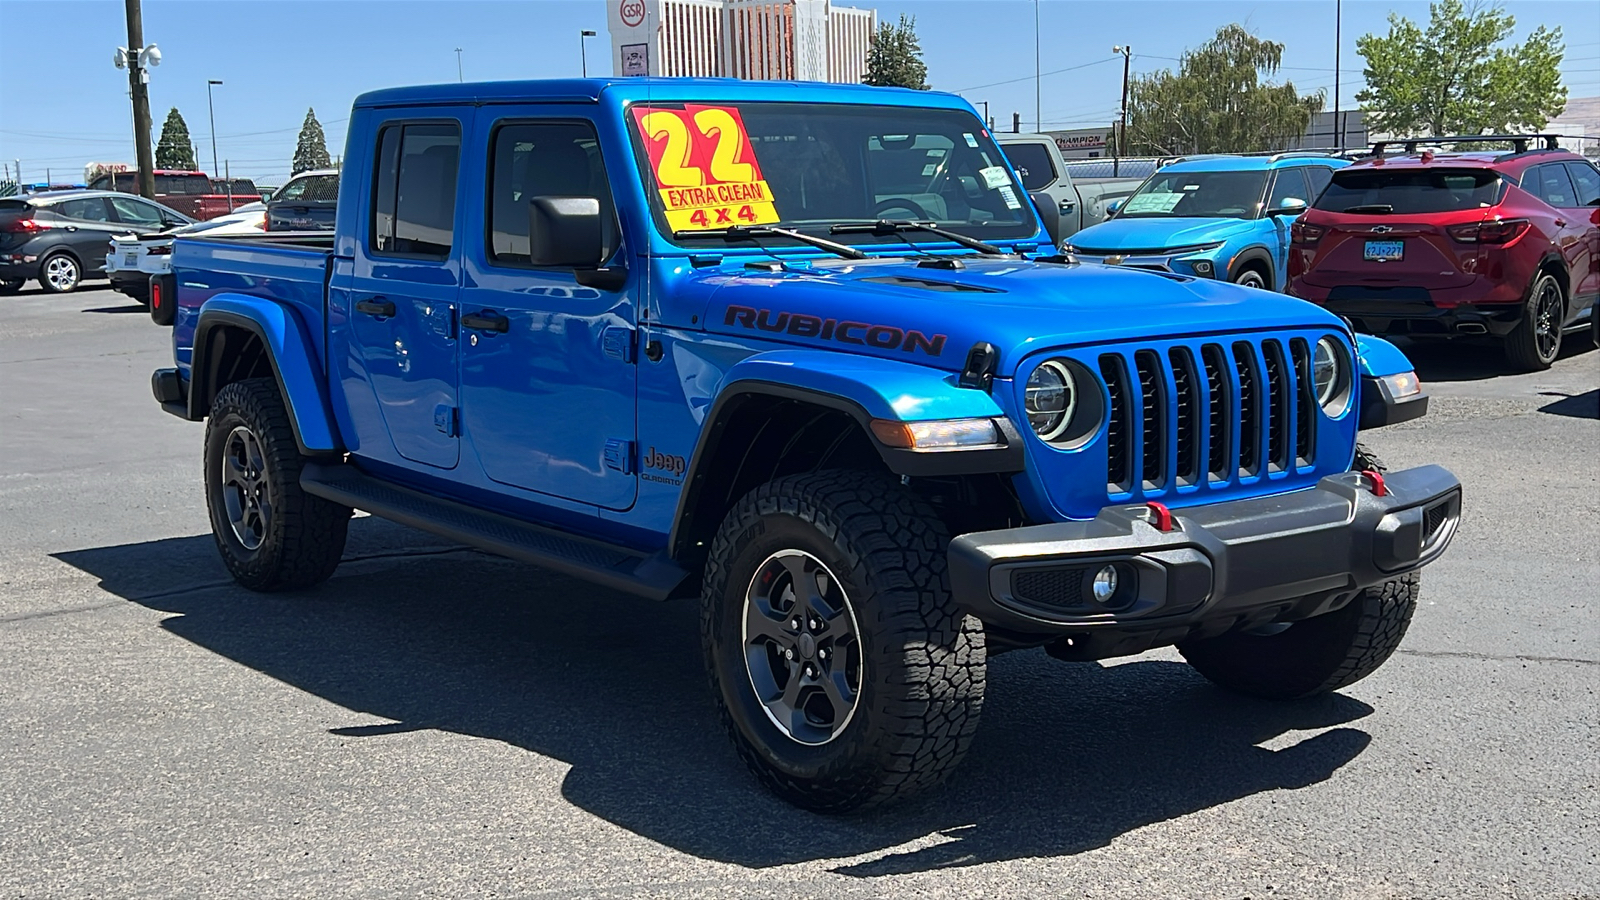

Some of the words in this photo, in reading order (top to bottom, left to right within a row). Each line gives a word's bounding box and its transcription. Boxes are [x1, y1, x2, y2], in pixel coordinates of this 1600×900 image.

[623, 3, 642, 18] GSR
[641, 108, 757, 187] 22
[1055, 135, 1101, 145] CHAMPION
[668, 186, 718, 208] EXTRA
[718, 182, 764, 203] CLEAN
[723, 304, 948, 357] RUBICON
[643, 446, 686, 477] Jeep
[641, 473, 683, 486] GLADIATO
